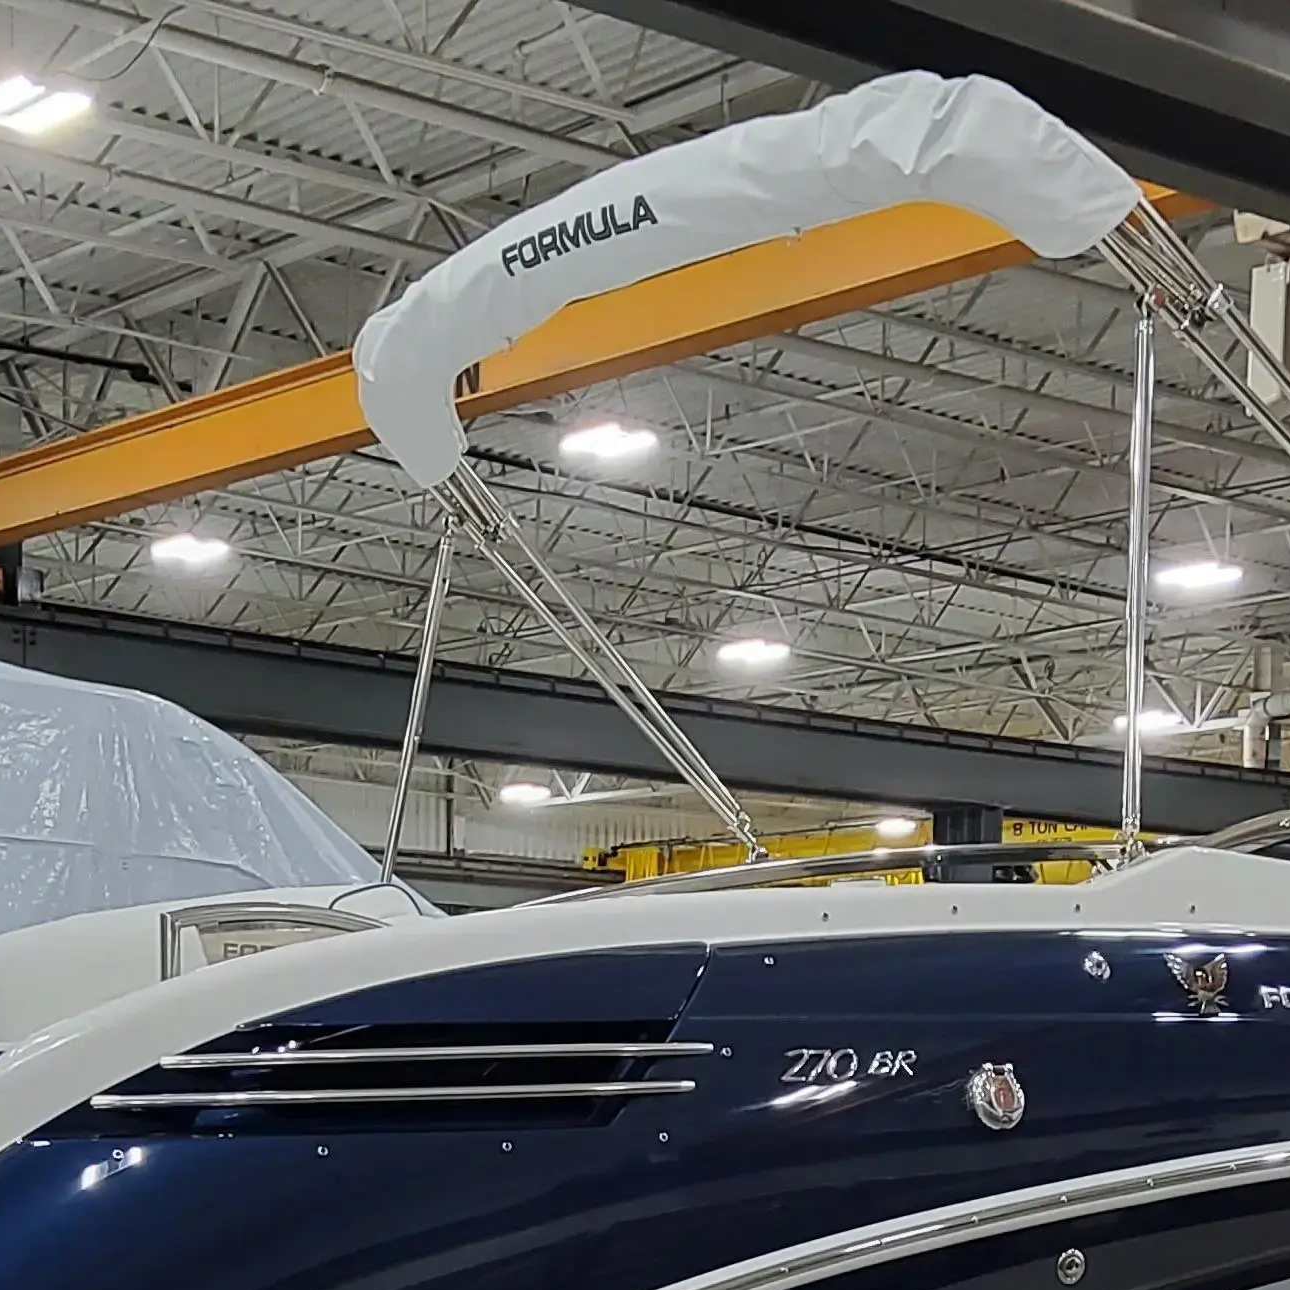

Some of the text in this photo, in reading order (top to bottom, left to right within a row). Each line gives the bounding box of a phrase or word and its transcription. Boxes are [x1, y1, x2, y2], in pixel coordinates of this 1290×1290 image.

[501, 194, 658, 276] FORMULA
[1013, 822, 1023, 836] 8
[780, 1048, 918, 1083] 270 BR
